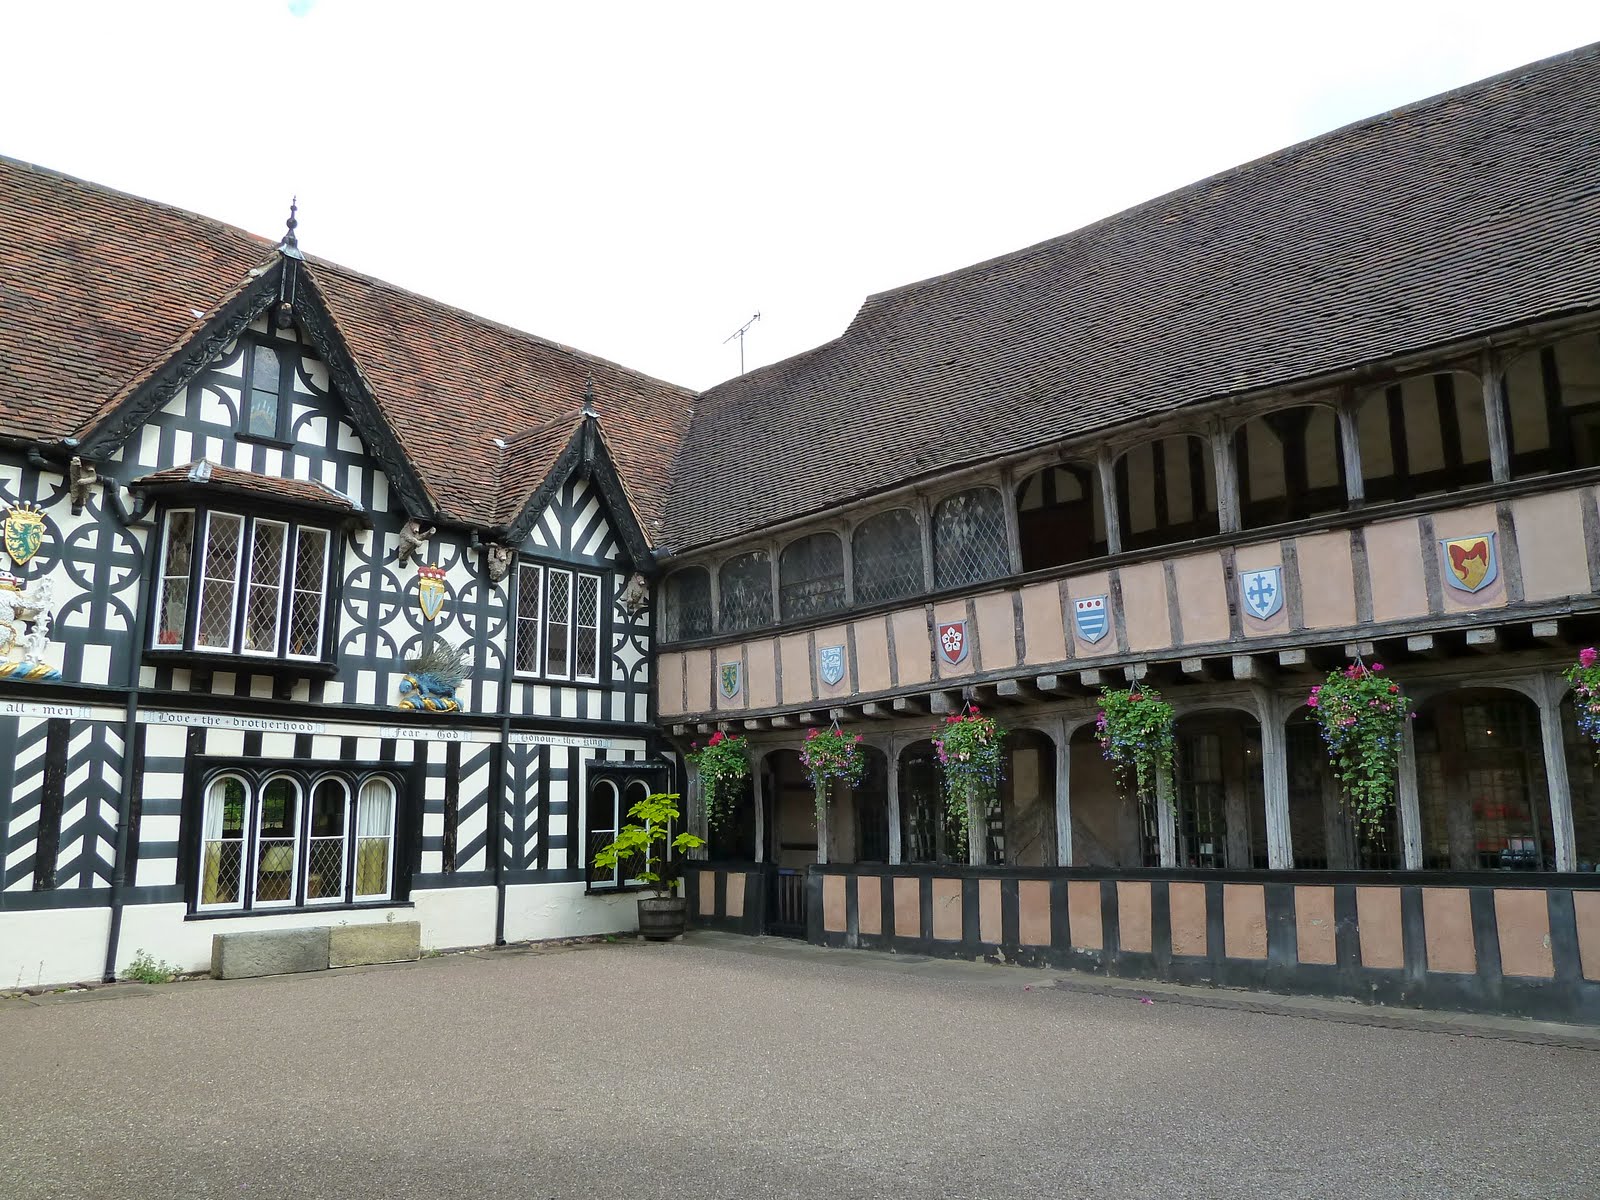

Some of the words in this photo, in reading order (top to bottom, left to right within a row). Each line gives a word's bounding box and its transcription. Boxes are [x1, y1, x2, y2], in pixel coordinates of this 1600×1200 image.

[6, 703, 25, 713] all
[43, 706, 73, 716] men
[159, 711, 190, 723] Love
[202, 716, 221, 726] the
[233, 717, 313, 731] brotherhood
[437, 729, 459, 739] God
[563, 736, 575, 745] the
